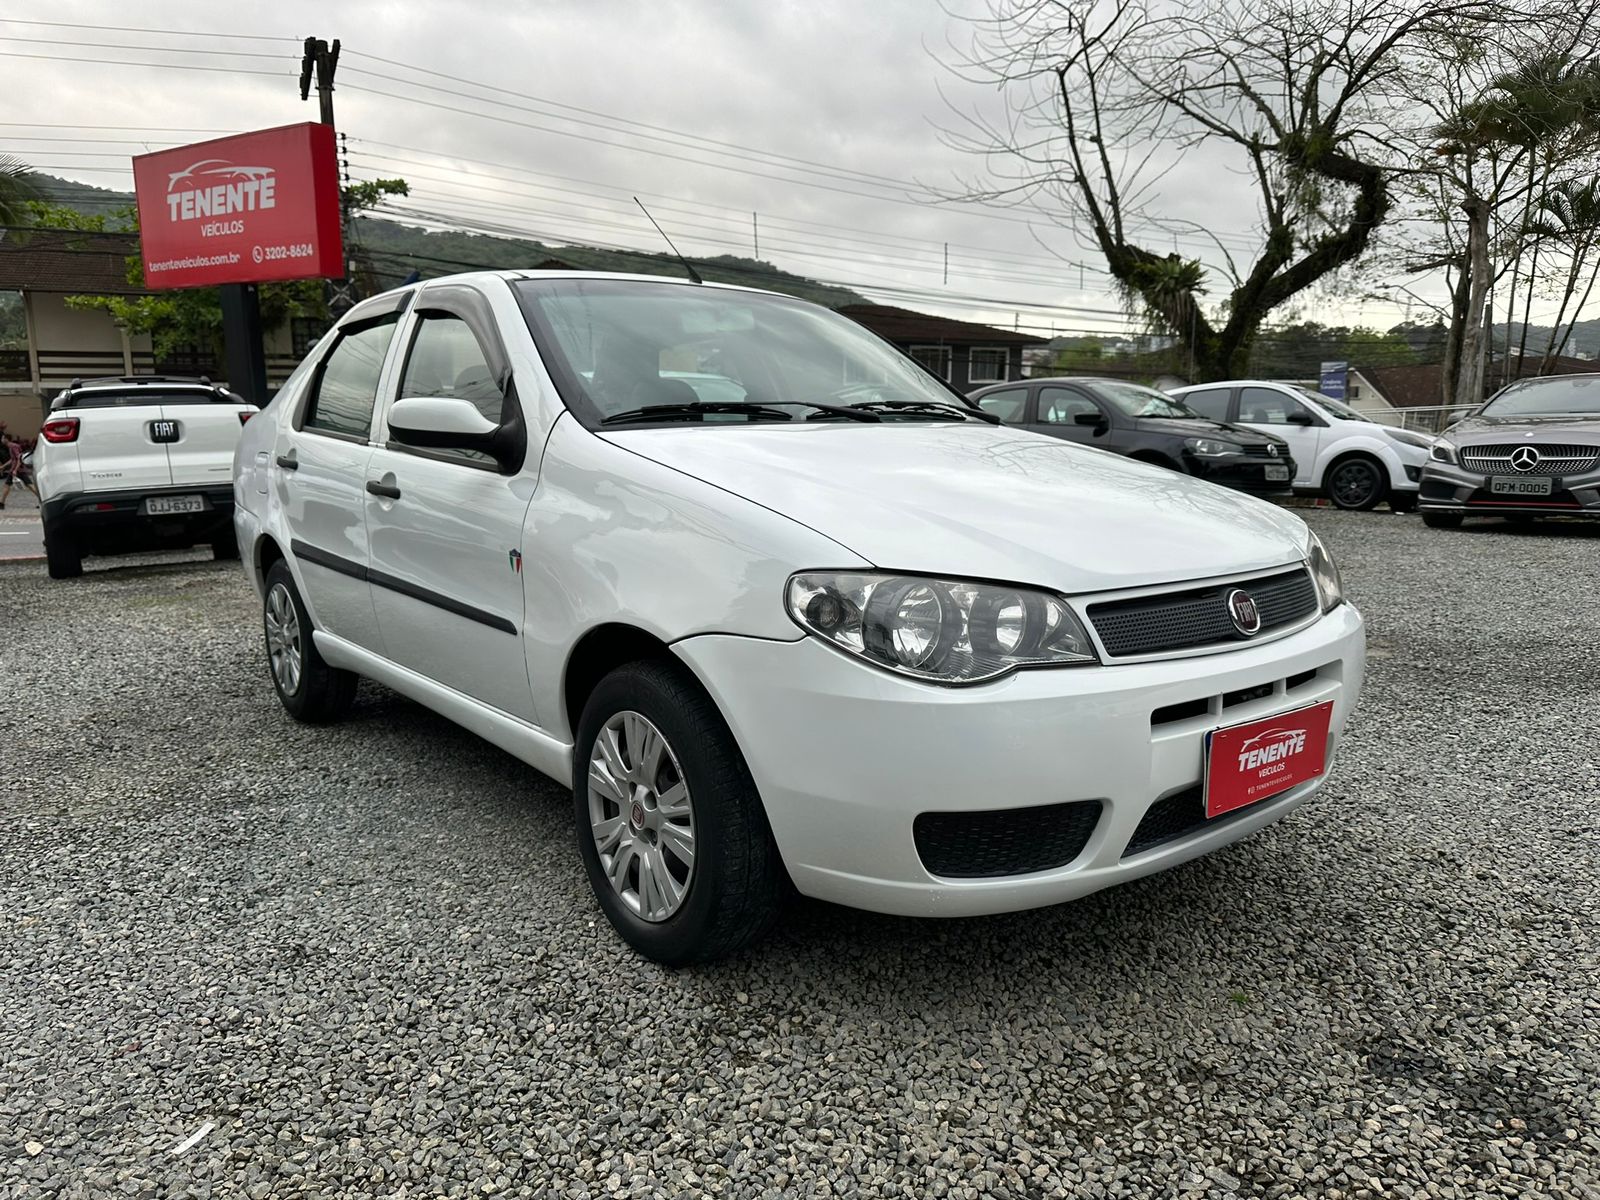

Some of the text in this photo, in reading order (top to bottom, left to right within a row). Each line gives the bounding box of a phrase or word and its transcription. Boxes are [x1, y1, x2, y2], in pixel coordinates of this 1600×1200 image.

[167, 177, 276, 222] TENENTE
[200, 219, 244, 237] VEÍCULOS
[264, 243, 313, 260] 3202-8624
[149, 252, 240, 272] tenenteveiculos.com.br
[154, 422, 174, 436] FIAT
[1238, 734, 1306, 772] TENENTE
